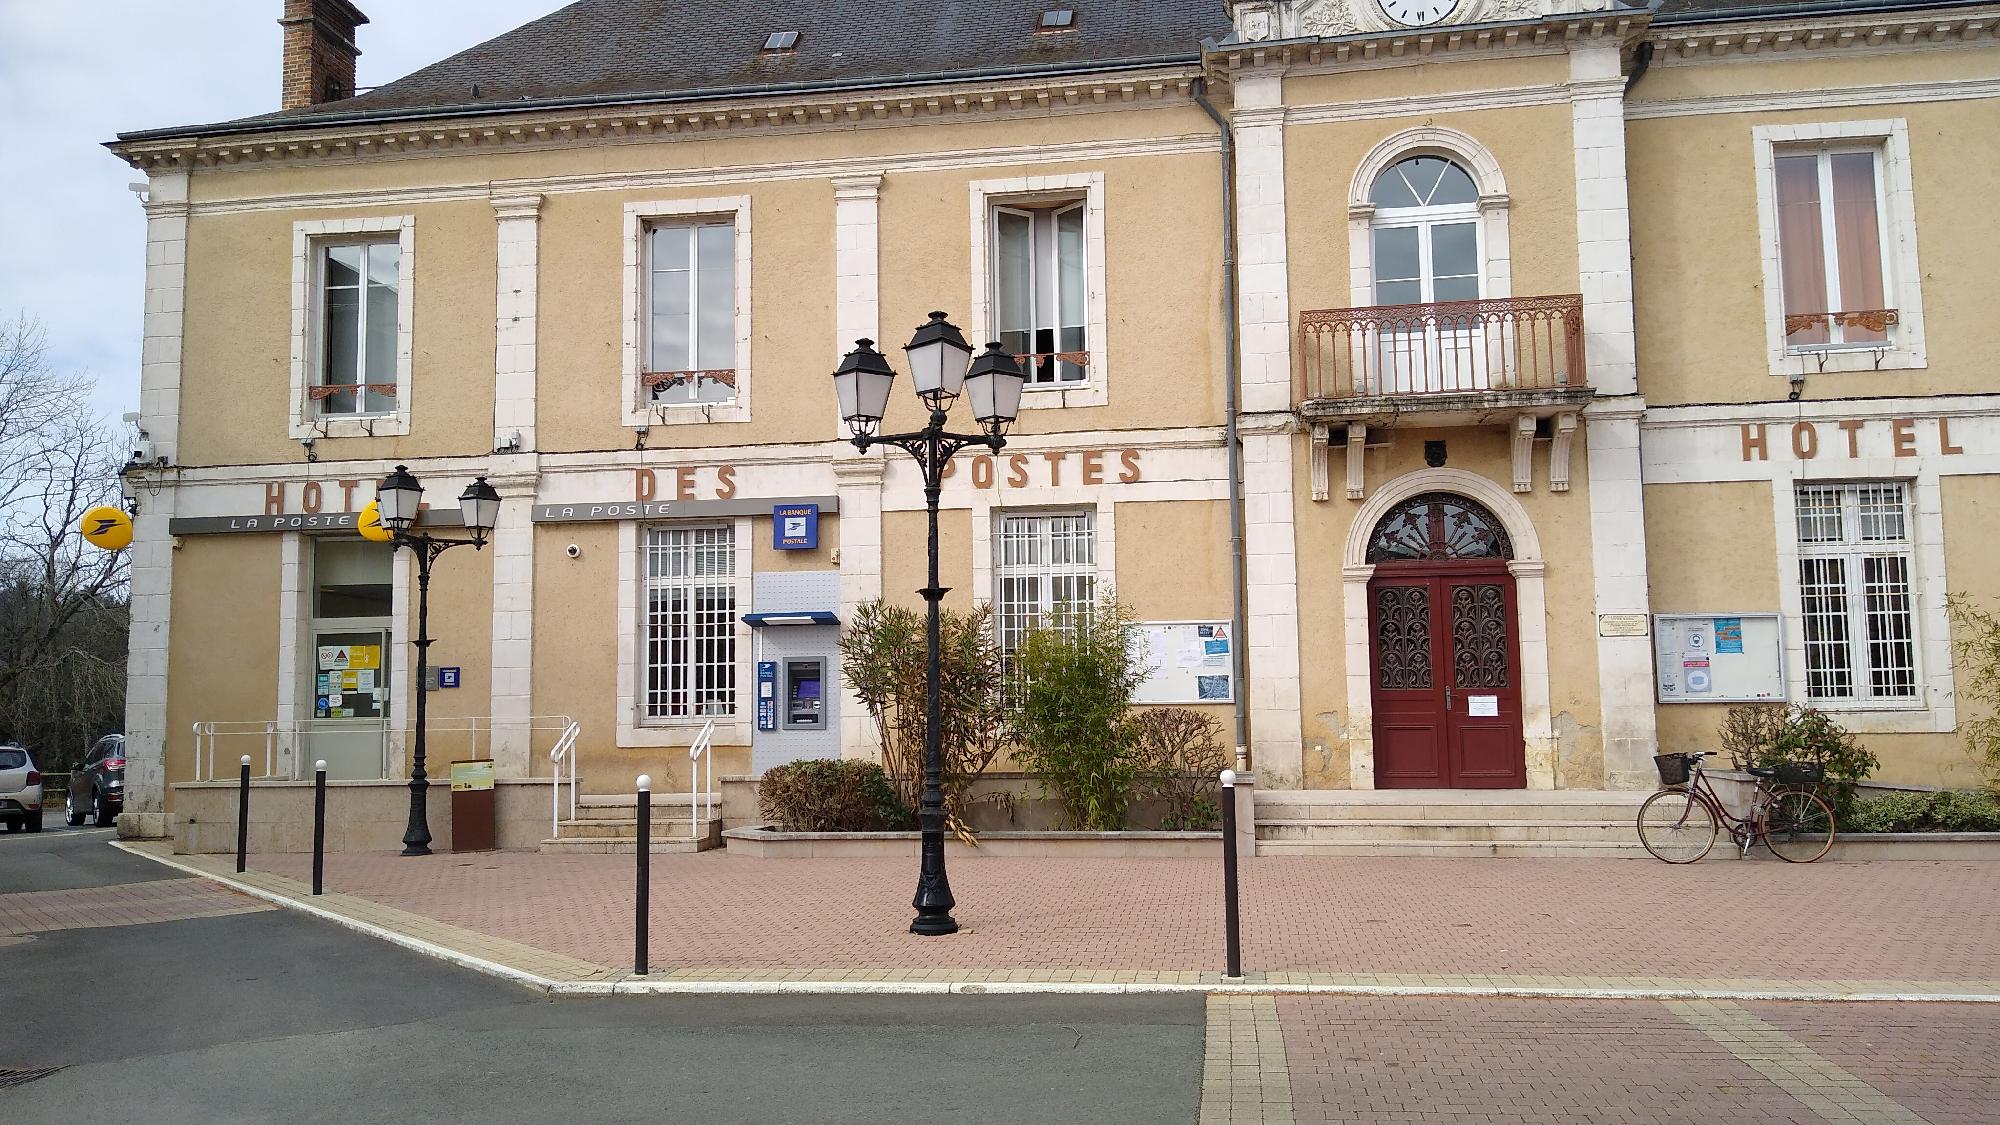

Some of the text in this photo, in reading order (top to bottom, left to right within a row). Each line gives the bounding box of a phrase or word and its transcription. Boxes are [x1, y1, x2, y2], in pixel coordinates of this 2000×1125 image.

[1740, 416, 1963, 461] HOTEL
[264, 479, 430, 516] HOT
[636, 464, 736, 502] DES
[230, 515, 351, 529] LA POSTE
[545, 504, 671, 518] LA POSTE
